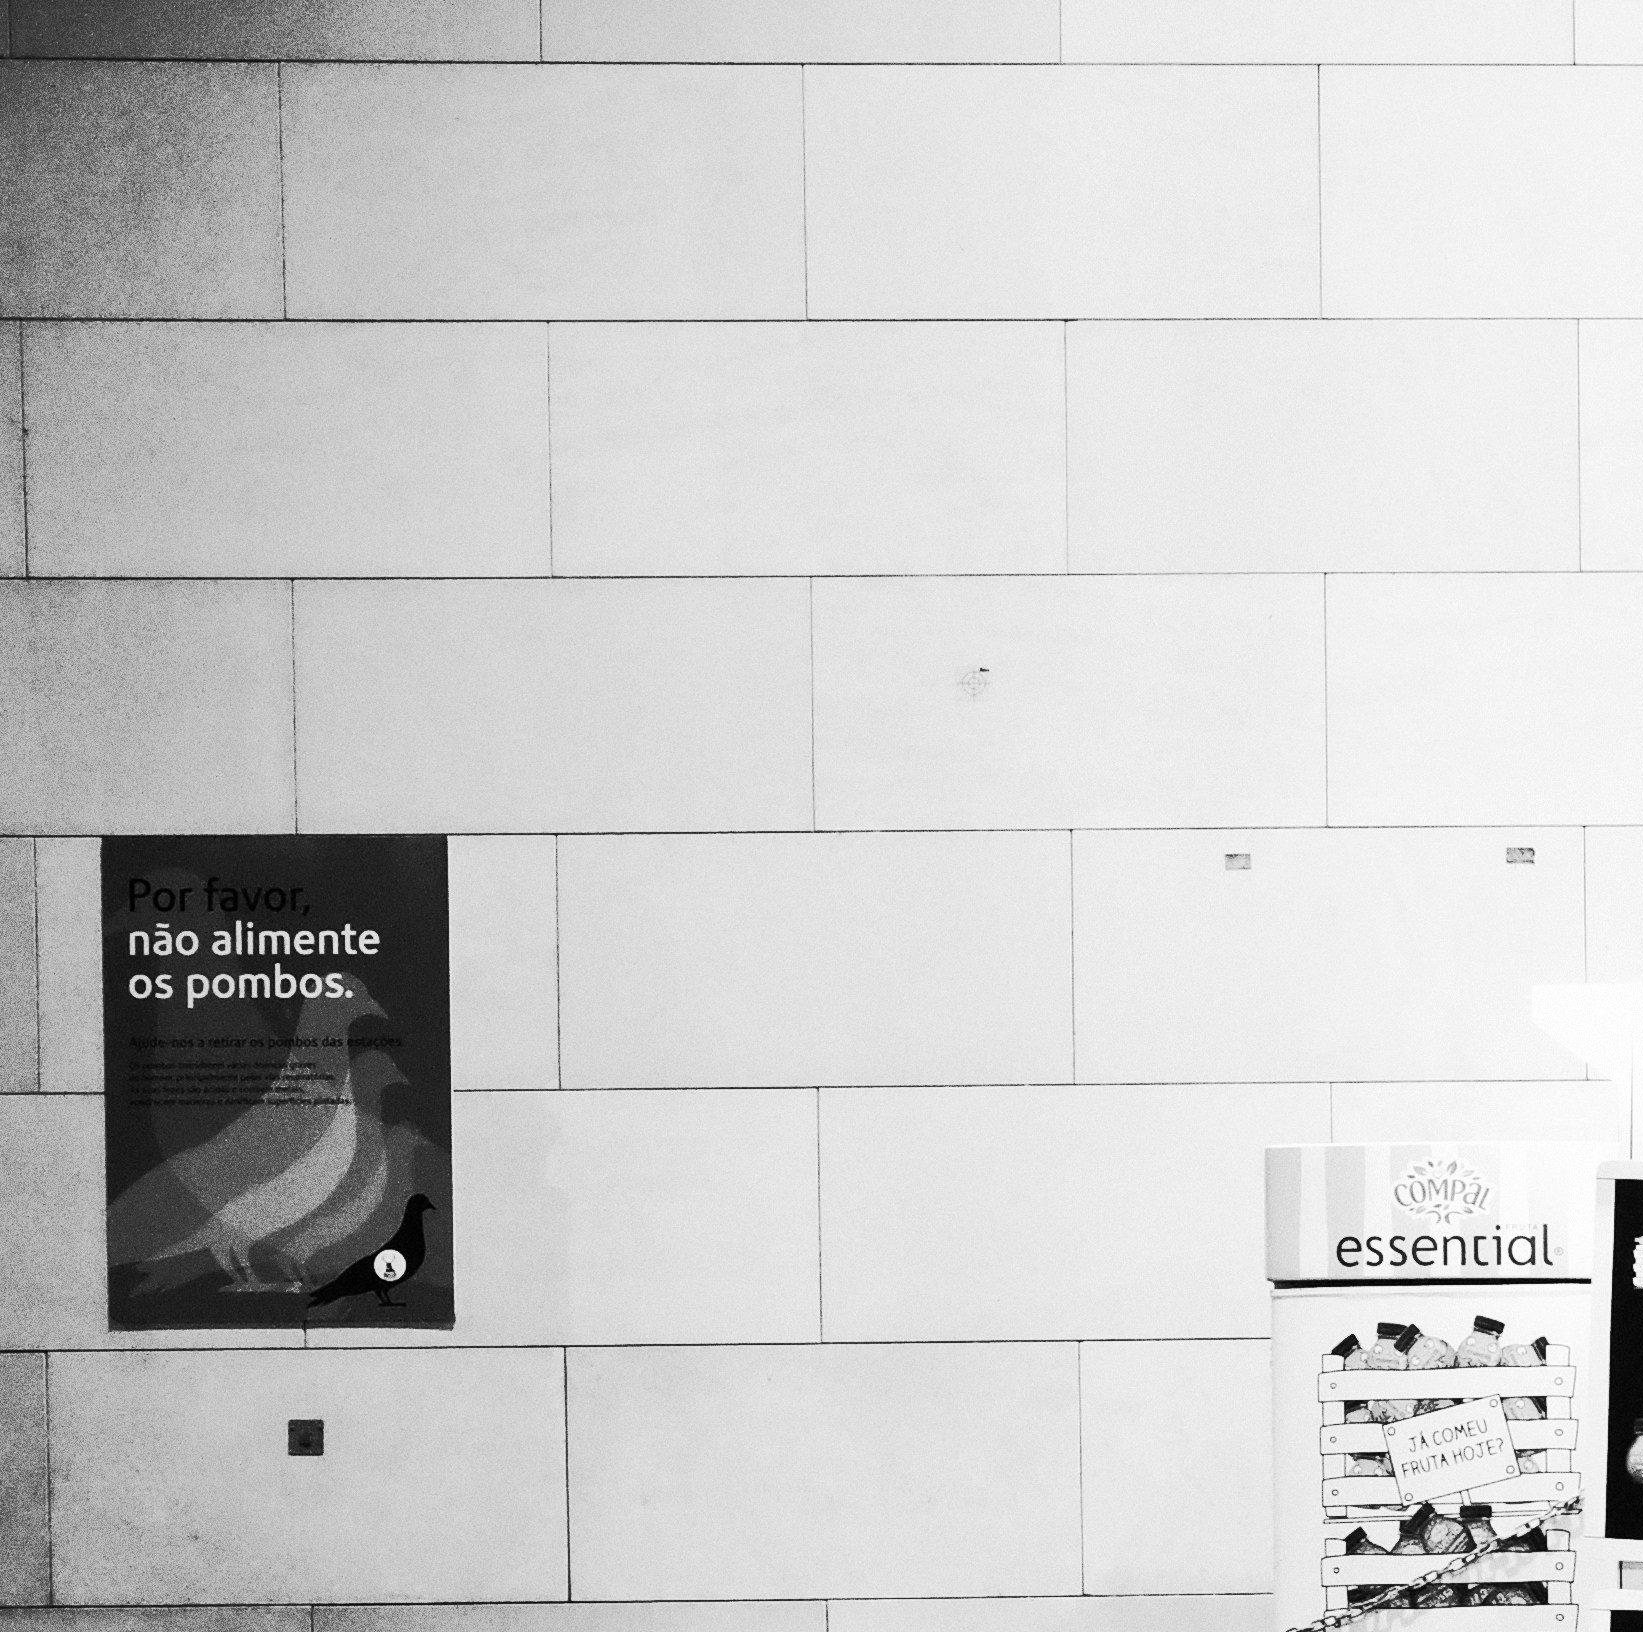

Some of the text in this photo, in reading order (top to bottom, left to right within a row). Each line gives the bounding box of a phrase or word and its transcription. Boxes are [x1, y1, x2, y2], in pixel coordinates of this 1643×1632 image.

[128, 876, 311, 917] Por favor,
[128, 921, 380, 957] não alimente
[128, 963, 354, 1009] os pombos.
[1336, 1224, 1554, 1268] essential
[1408, 1418, 1488, 1454] JÁ COMEU
[1400, 1437, 1506, 1479] FRUTA HOJE?
